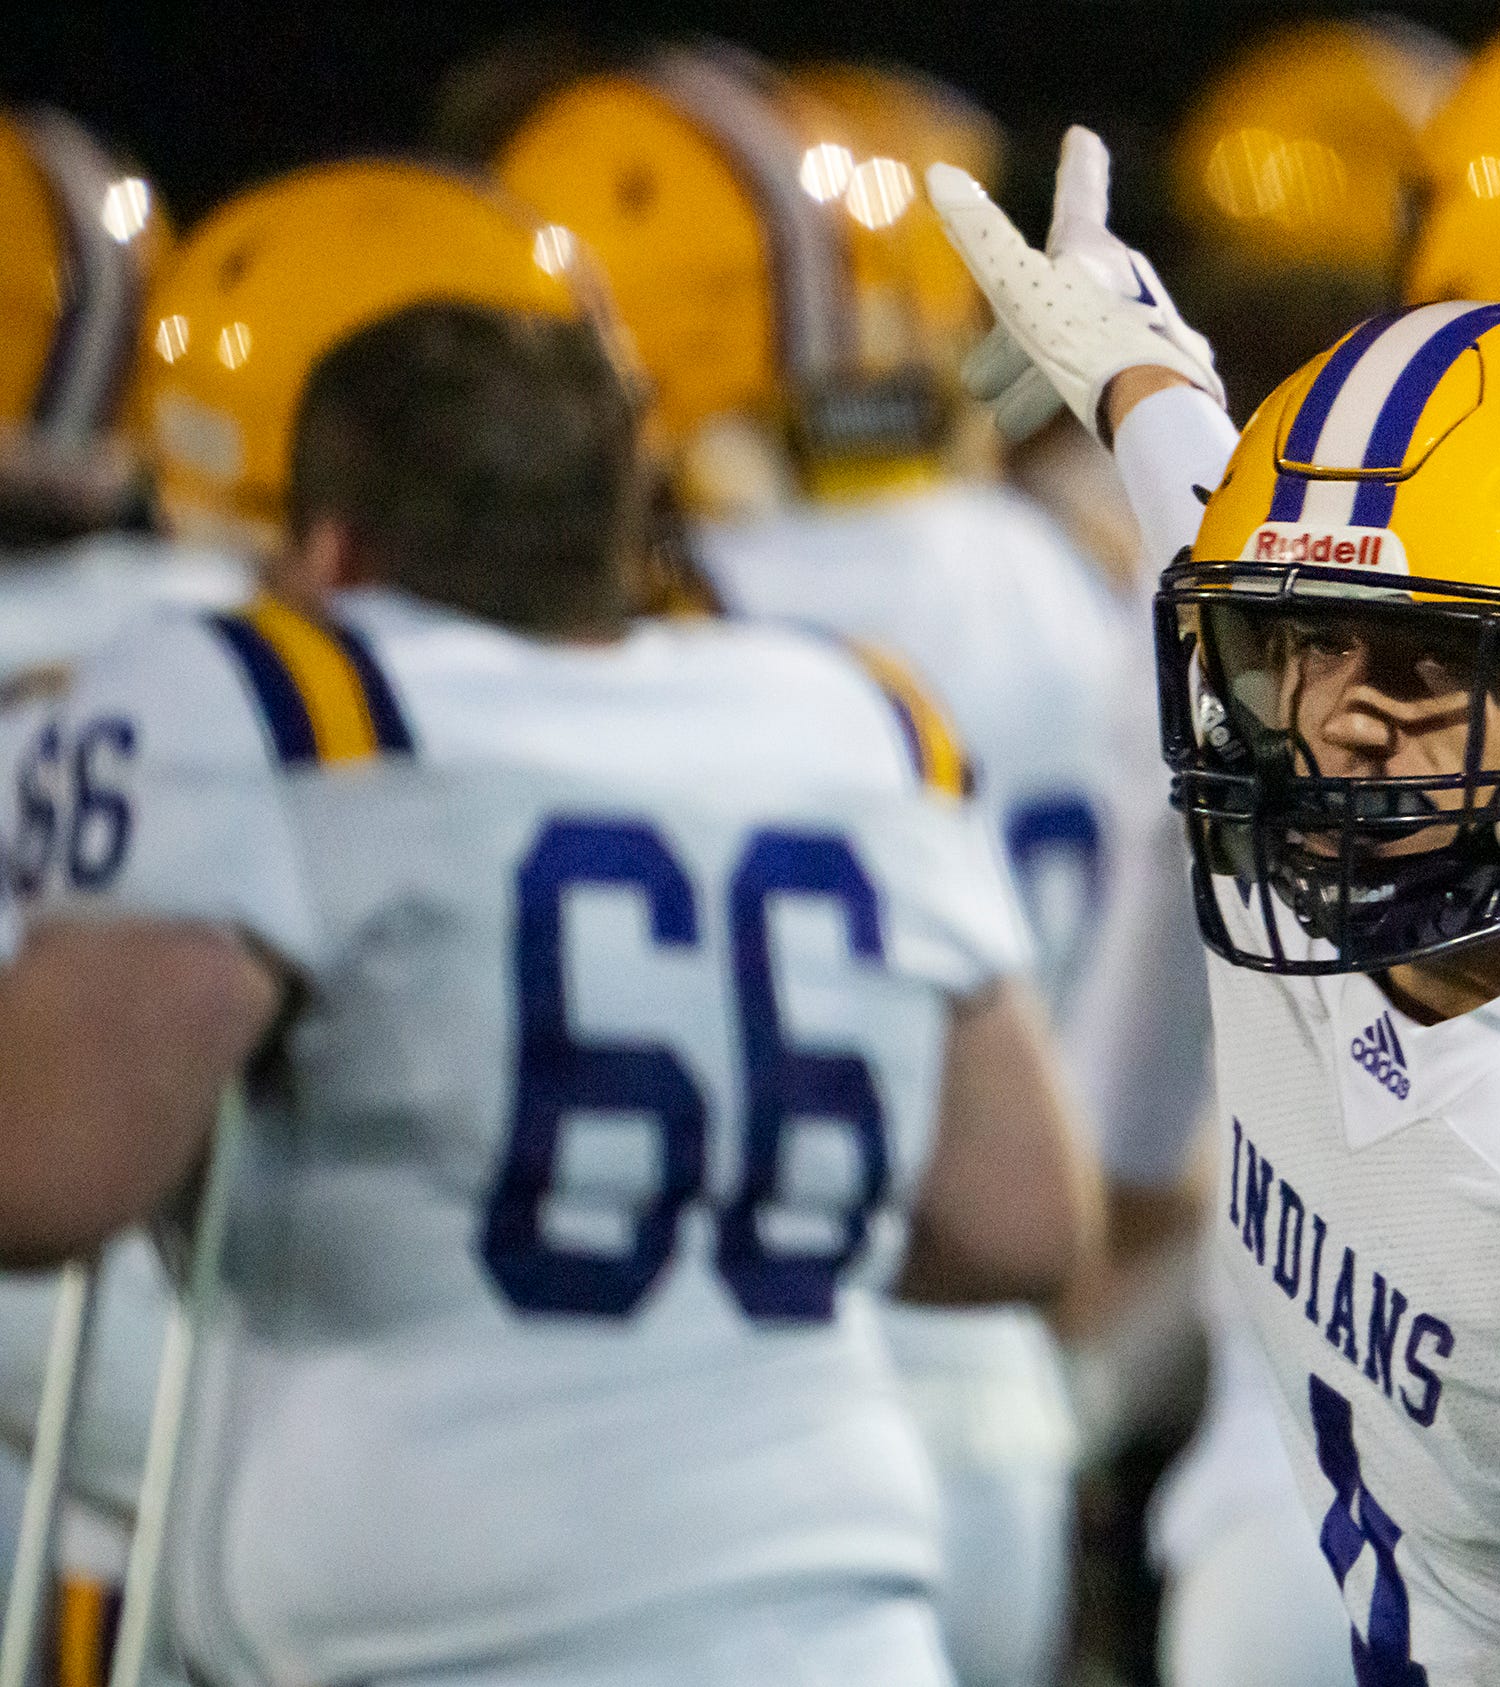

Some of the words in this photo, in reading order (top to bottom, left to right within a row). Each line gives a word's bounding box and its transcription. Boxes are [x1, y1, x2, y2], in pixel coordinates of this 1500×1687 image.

[1255, 530, 1383, 567] Riddell
[478, 814, 892, 1328] 66
[1350, 1036, 1411, 1101] adidas
[1229, 1114, 1456, 1428] INDIANS
[1308, 1372, 1430, 1687] 4
